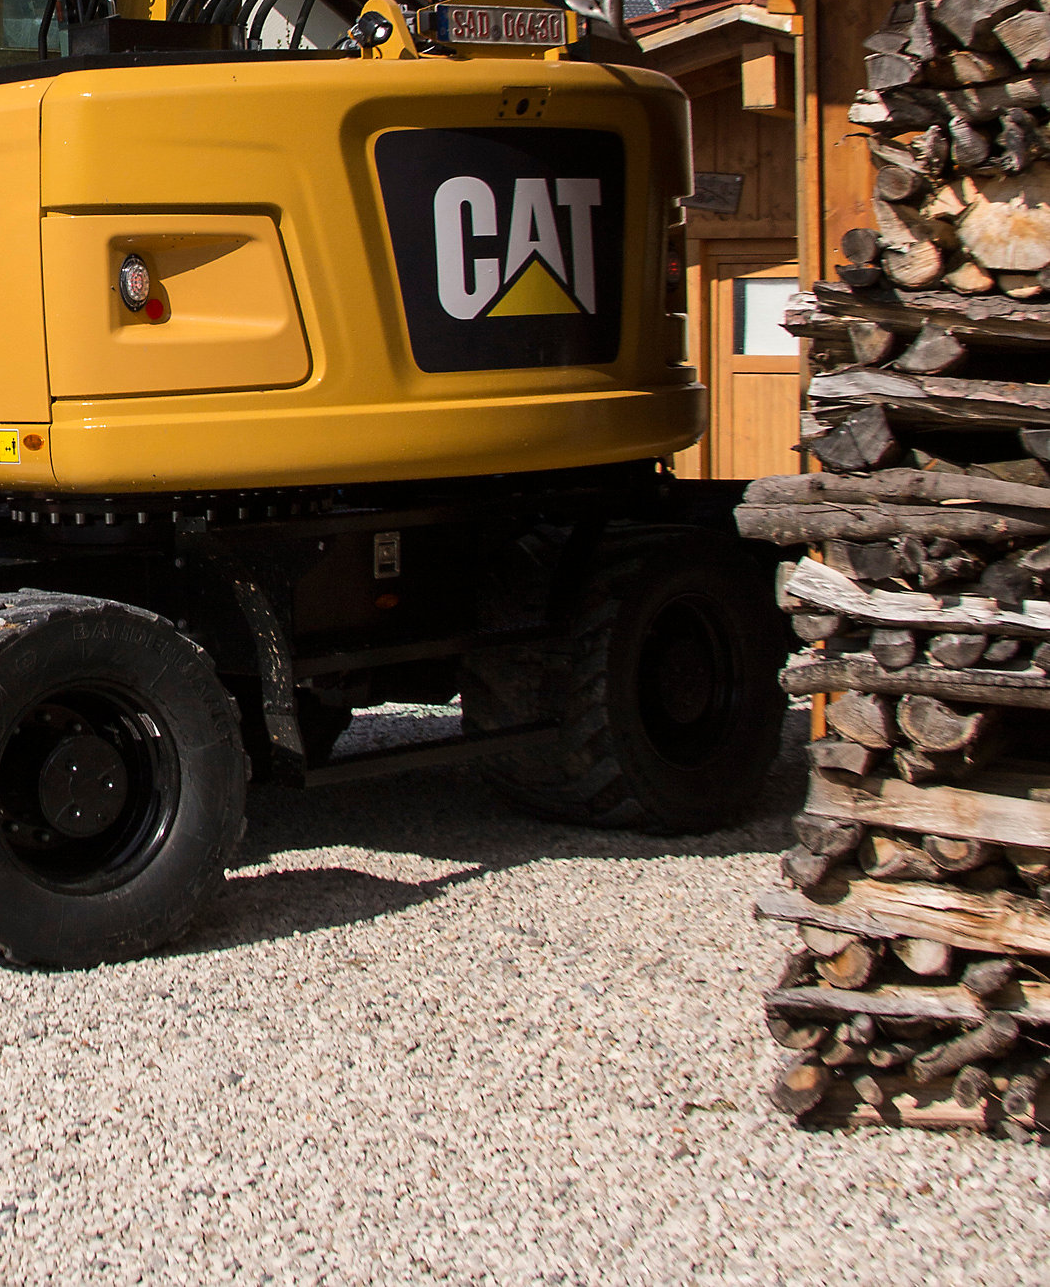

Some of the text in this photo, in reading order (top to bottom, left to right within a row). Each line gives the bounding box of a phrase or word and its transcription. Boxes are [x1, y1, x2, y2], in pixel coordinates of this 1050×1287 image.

[452, 9, 561, 41] SAD 06430
[434, 175, 601, 320] CAT
